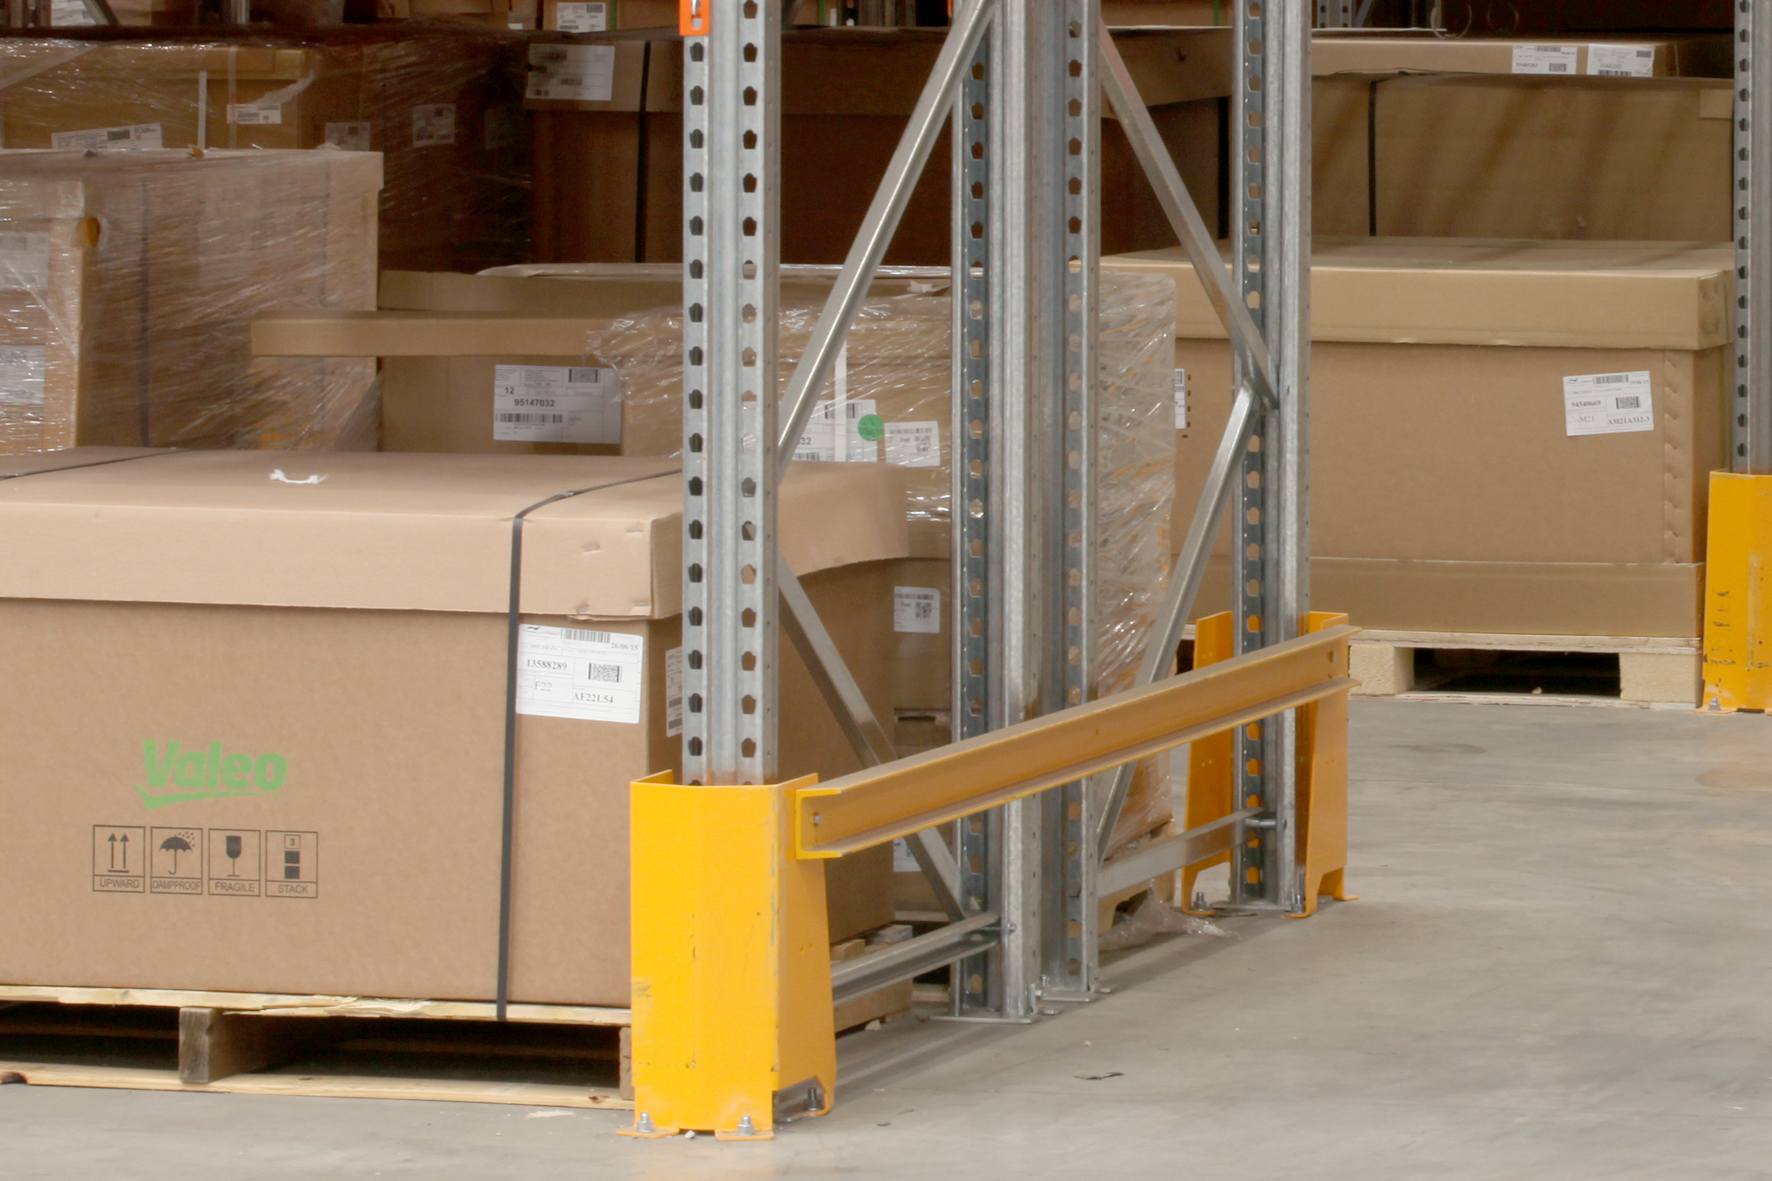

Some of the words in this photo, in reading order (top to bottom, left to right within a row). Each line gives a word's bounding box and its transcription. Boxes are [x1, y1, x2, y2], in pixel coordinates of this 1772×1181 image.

[505, 386, 515, 395] 12
[514, 399, 555, 407] 95147032
[526, 659, 568, 670] 13588289
[534, 680, 552, 692] F22
[572, 692, 614, 704] AF22L54
[142, 739, 288, 791] Valeo
[290, 837, 296, 846] 3
[100, 879, 140, 889] UPWARD
[152, 879, 201, 890] DAMPPROOF
[215, 881, 255, 892] FRAGILE
[277, 884, 309, 894] STACK
